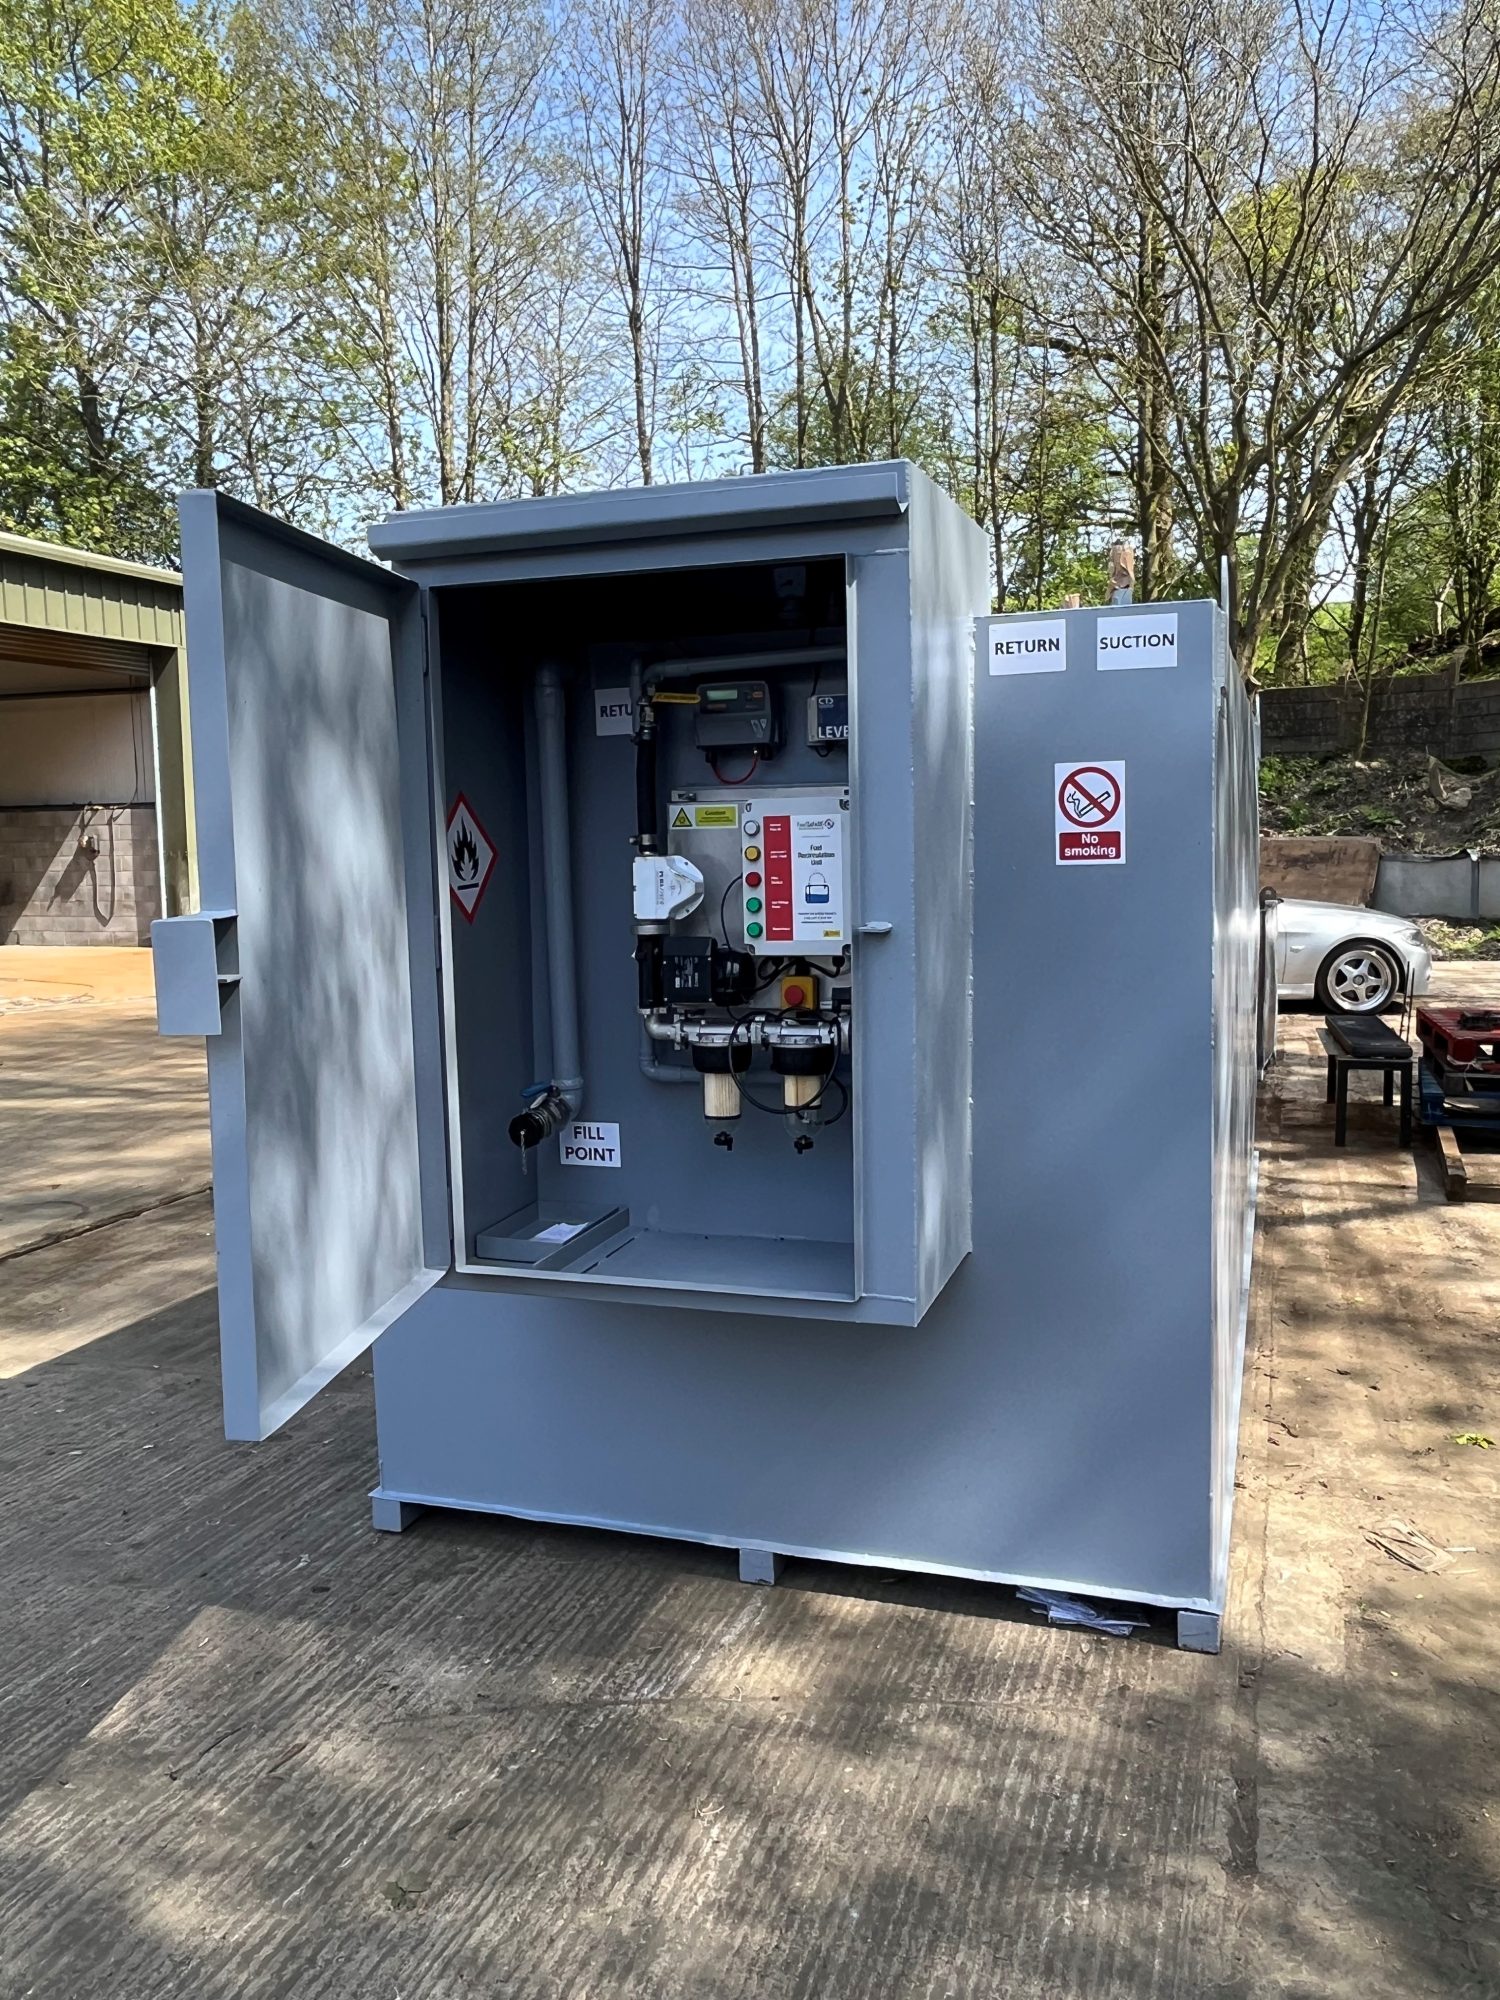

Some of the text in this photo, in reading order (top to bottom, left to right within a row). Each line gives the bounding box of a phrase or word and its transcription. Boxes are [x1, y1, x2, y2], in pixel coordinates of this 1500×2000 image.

[994, 637, 1060, 655] RETURN
[1099, 633, 1175, 650] SUCTION
[600, 704, 633, 718] RETU
[818, 726, 848, 738] LEVE
[1081, 833, 1099, 845] No
[1064, 845, 1116, 858] smoking
[573, 1126, 605, 1141] FILL
[564, 1146, 616, 1162] POINT
